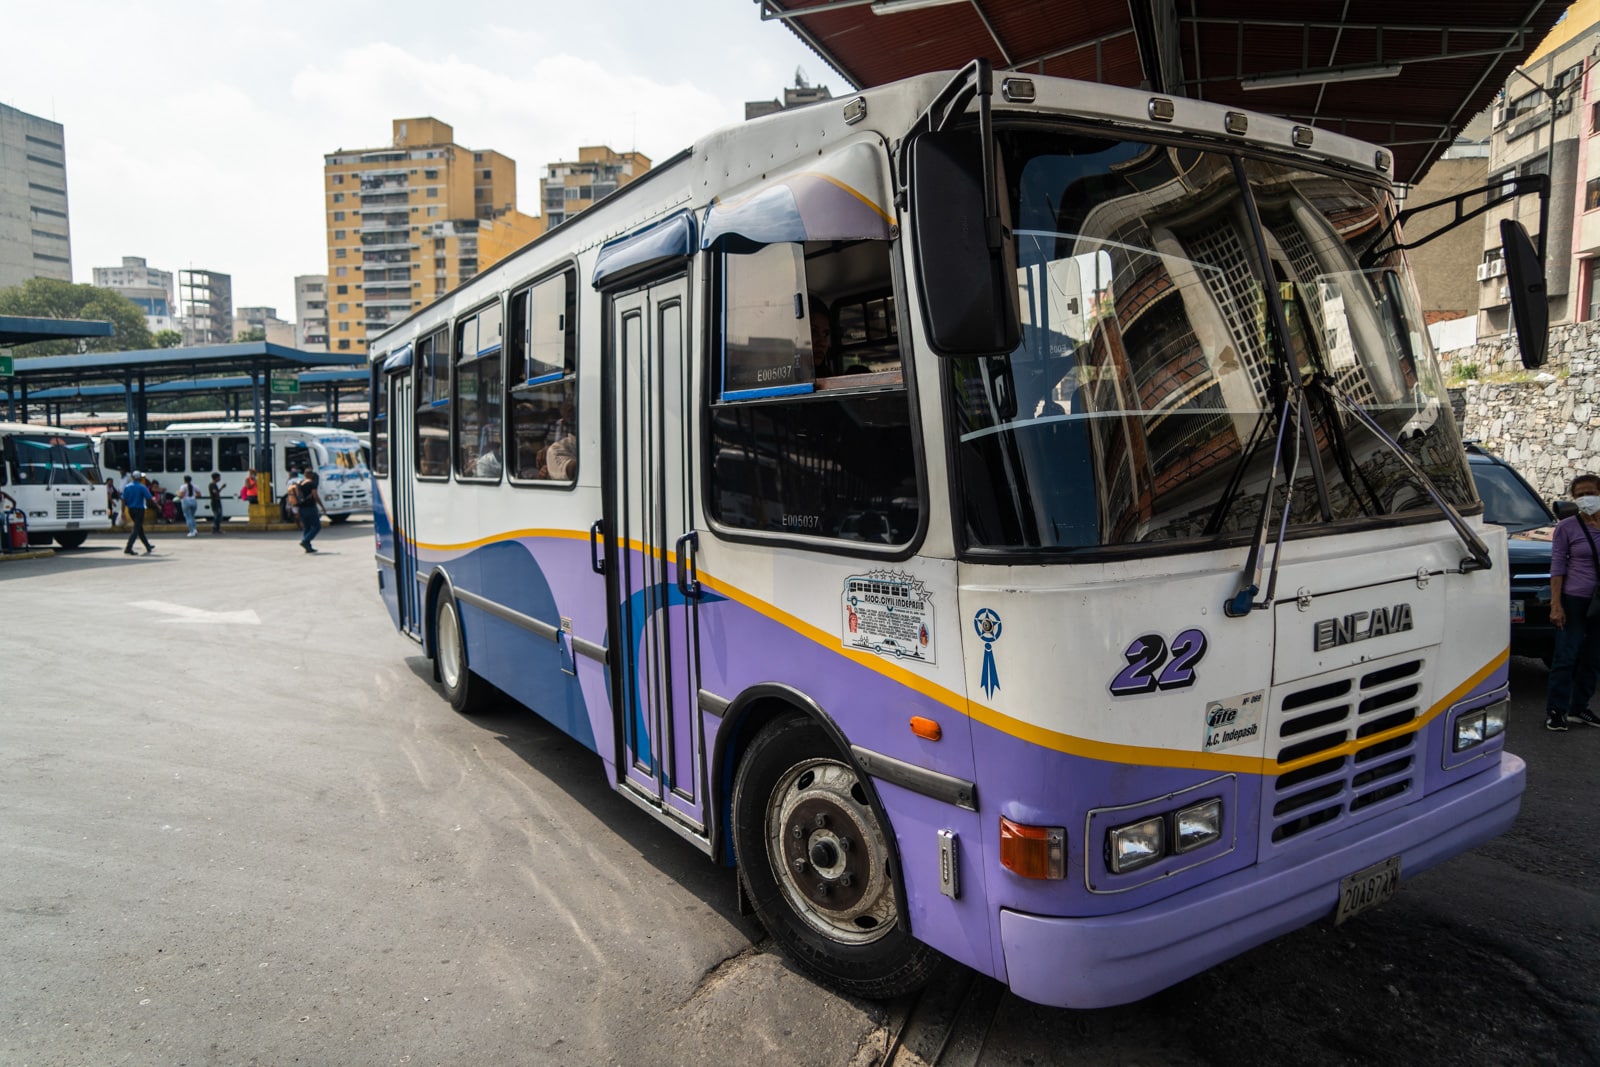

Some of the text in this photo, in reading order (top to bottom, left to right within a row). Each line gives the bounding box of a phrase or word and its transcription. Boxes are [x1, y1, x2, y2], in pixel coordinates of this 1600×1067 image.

[757, 365, 792, 382] E005037
[782, 514, 819, 528] E005037
[881, 597, 895, 606] CIVIL
[1314, 603, 1415, 652] ENCAVA
[1110, 628, 1208, 696] 22
[1205, 723, 1258, 748] A.C. Indepasib
